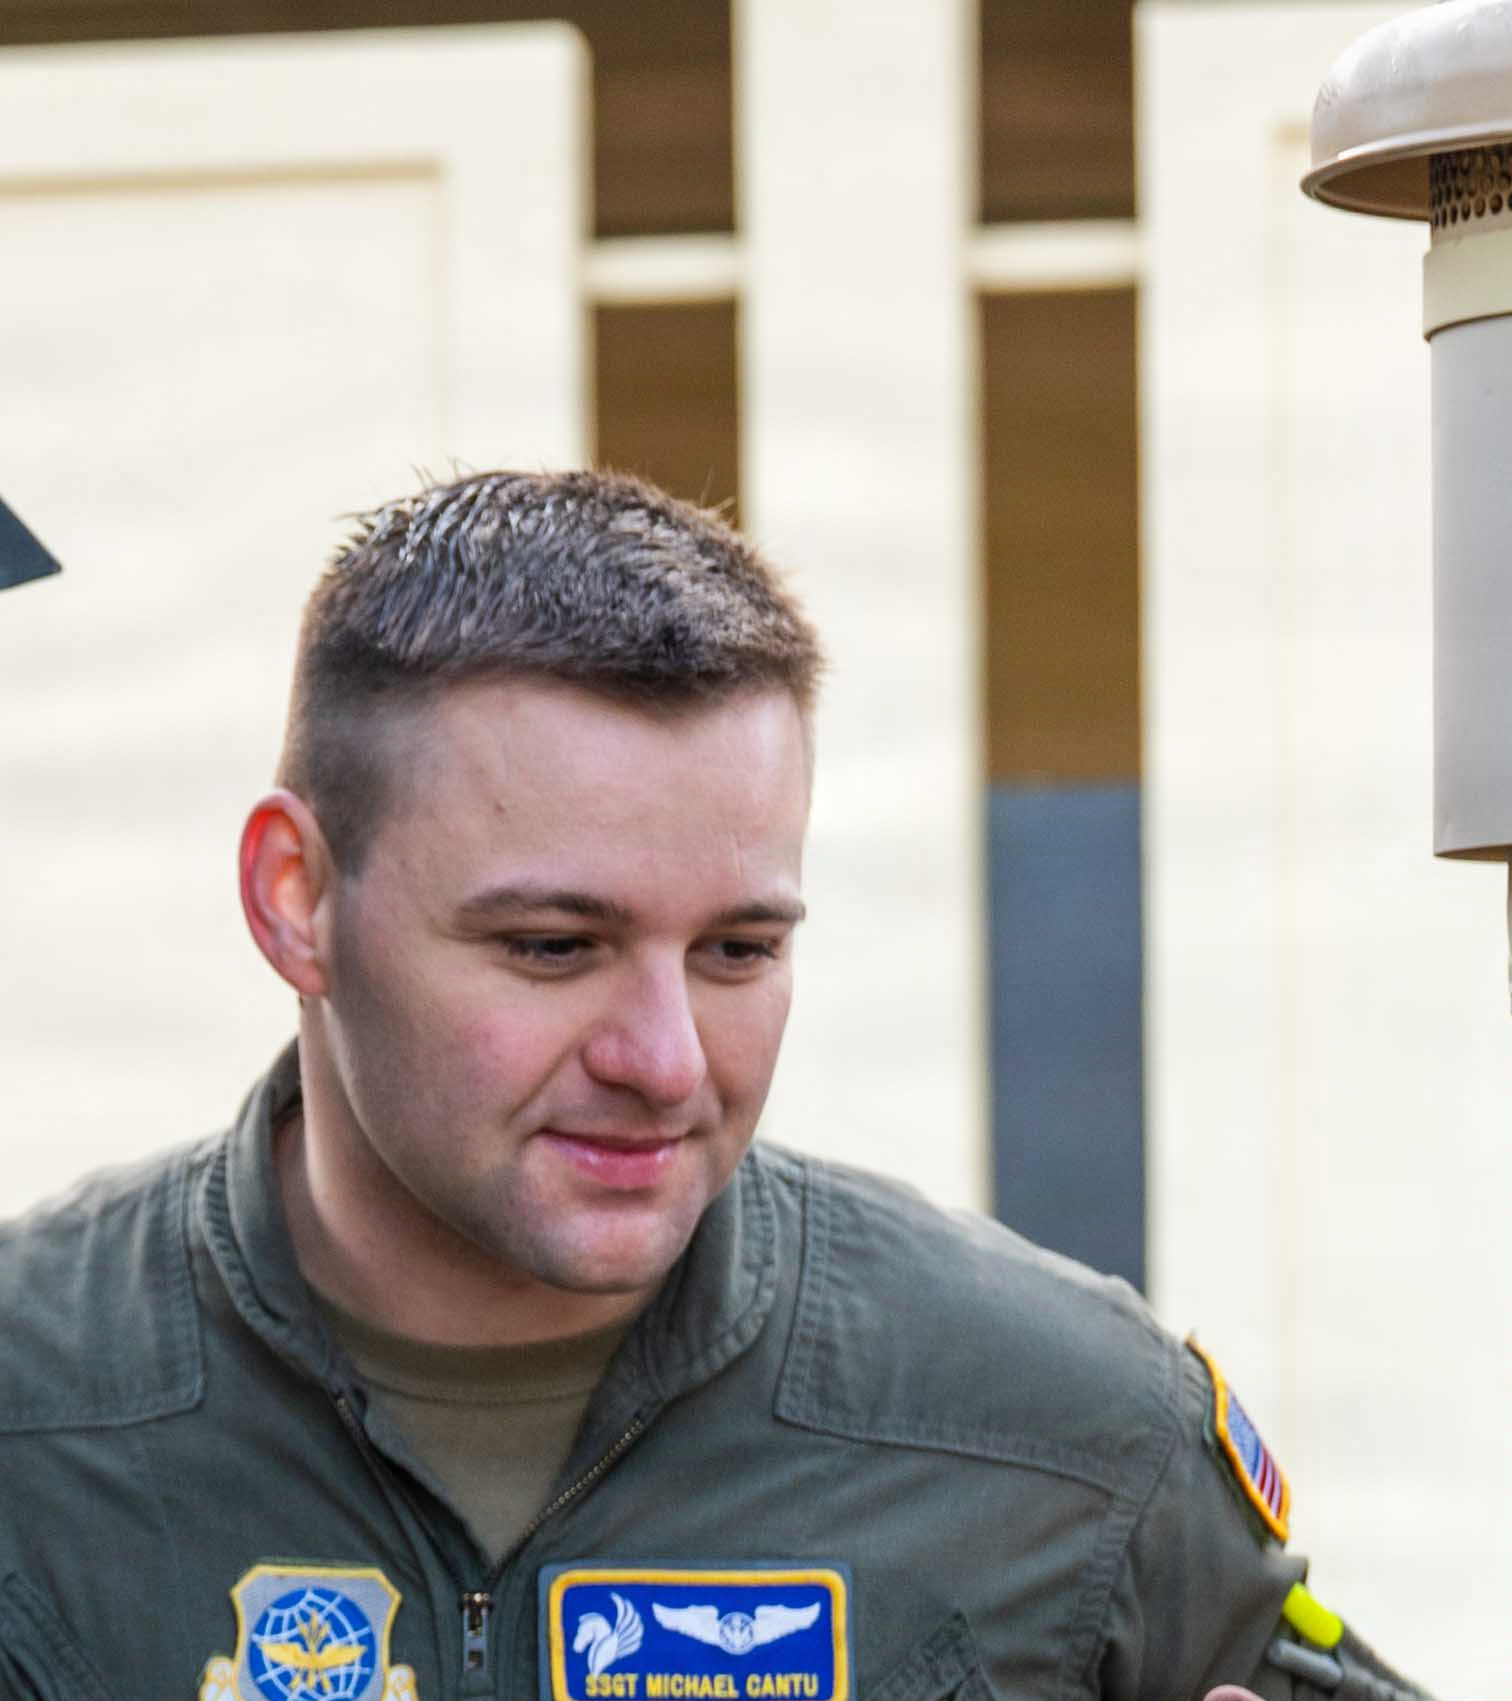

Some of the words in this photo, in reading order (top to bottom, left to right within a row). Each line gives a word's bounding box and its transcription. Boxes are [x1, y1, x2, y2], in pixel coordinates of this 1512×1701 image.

[586, 1673, 638, 1698] SSGT
[646, 1673, 739, 1699] MICHAEL
[746, 1673, 818, 1698] CANTU
